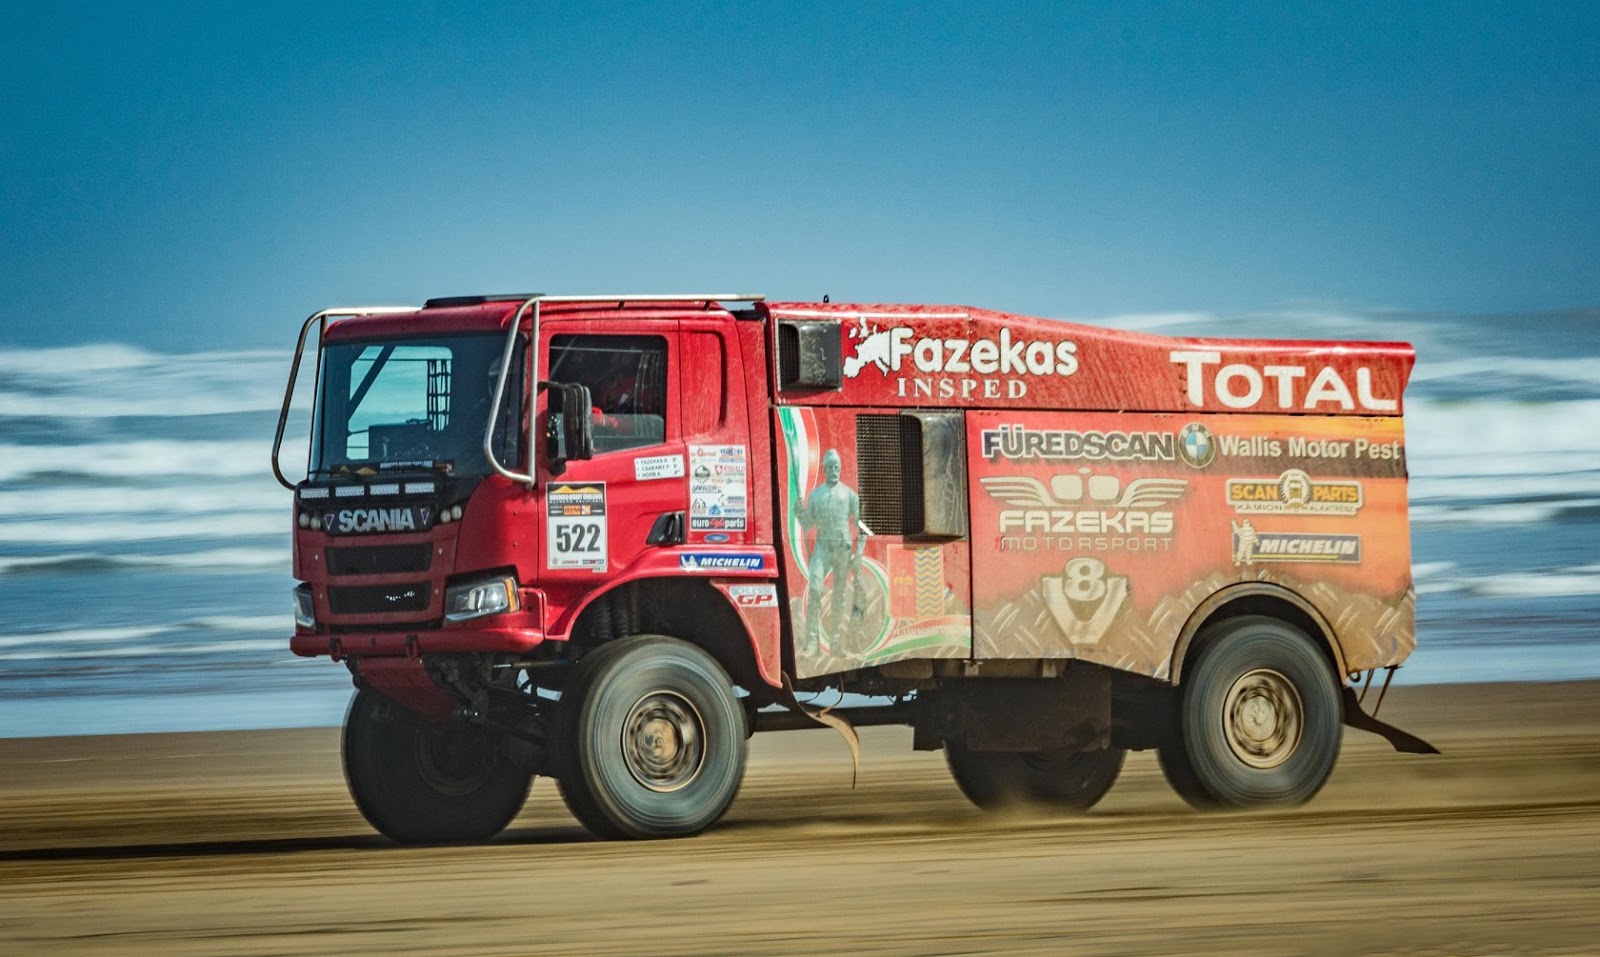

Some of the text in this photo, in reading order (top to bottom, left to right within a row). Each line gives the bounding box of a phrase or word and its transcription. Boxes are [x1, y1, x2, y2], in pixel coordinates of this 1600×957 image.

[889, 326, 1080, 377] Fazekas
[897, 377, 1029, 399] INSPED
[1169, 351, 1398, 411] TOTAL
[981, 424, 1175, 461] FÜREDSCAN
[1218, 434, 1400, 460] Wallis Motor Pest
[1231, 484, 1358, 502] SCAN PARTS
[338, 508, 415, 532] SCANIA
[999, 510, 1174, 534] FAZEKAS
[556, 524, 601, 553] 522
[1001, 536, 1173, 551] MOTORSPORT
[1259, 539, 1357, 554] MICHELIN
[700, 557, 761, 568] MICHELIN
[737, 594, 773, 605] GP
